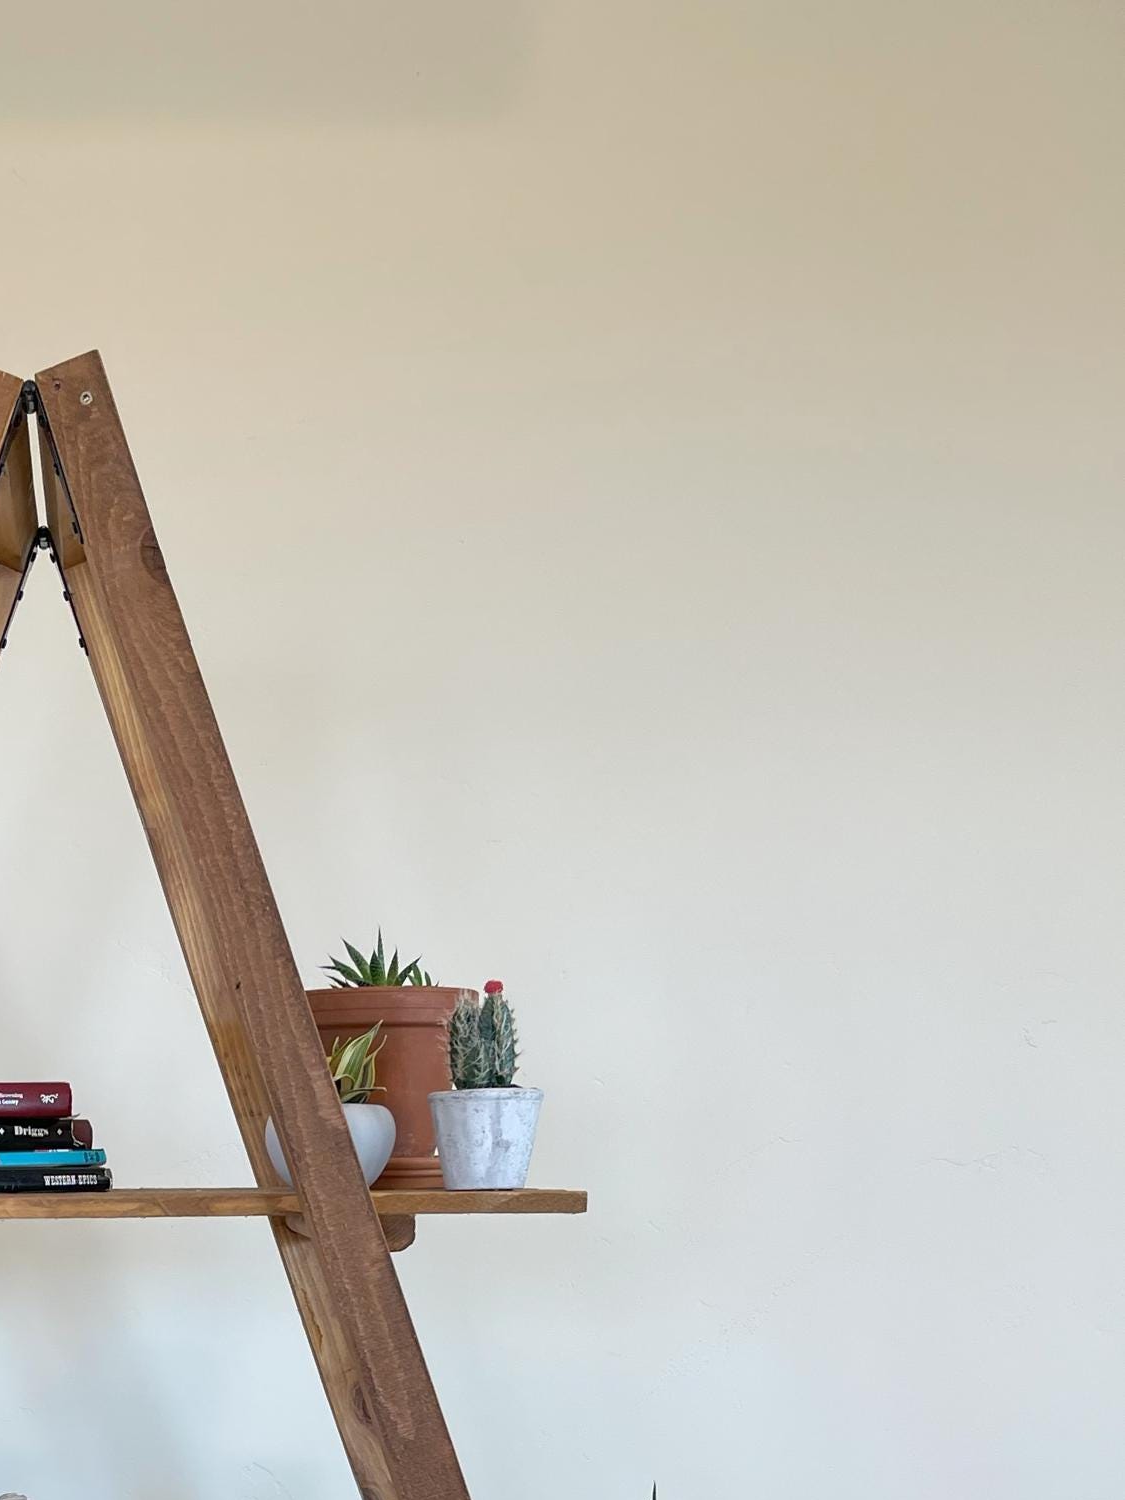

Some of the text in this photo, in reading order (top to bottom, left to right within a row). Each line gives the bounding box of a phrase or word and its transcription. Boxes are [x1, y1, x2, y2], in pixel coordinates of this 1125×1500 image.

[14, 1125, 49, 1137] Driggs
[43, 1174, 98, 1186] WESTERN EPICS
